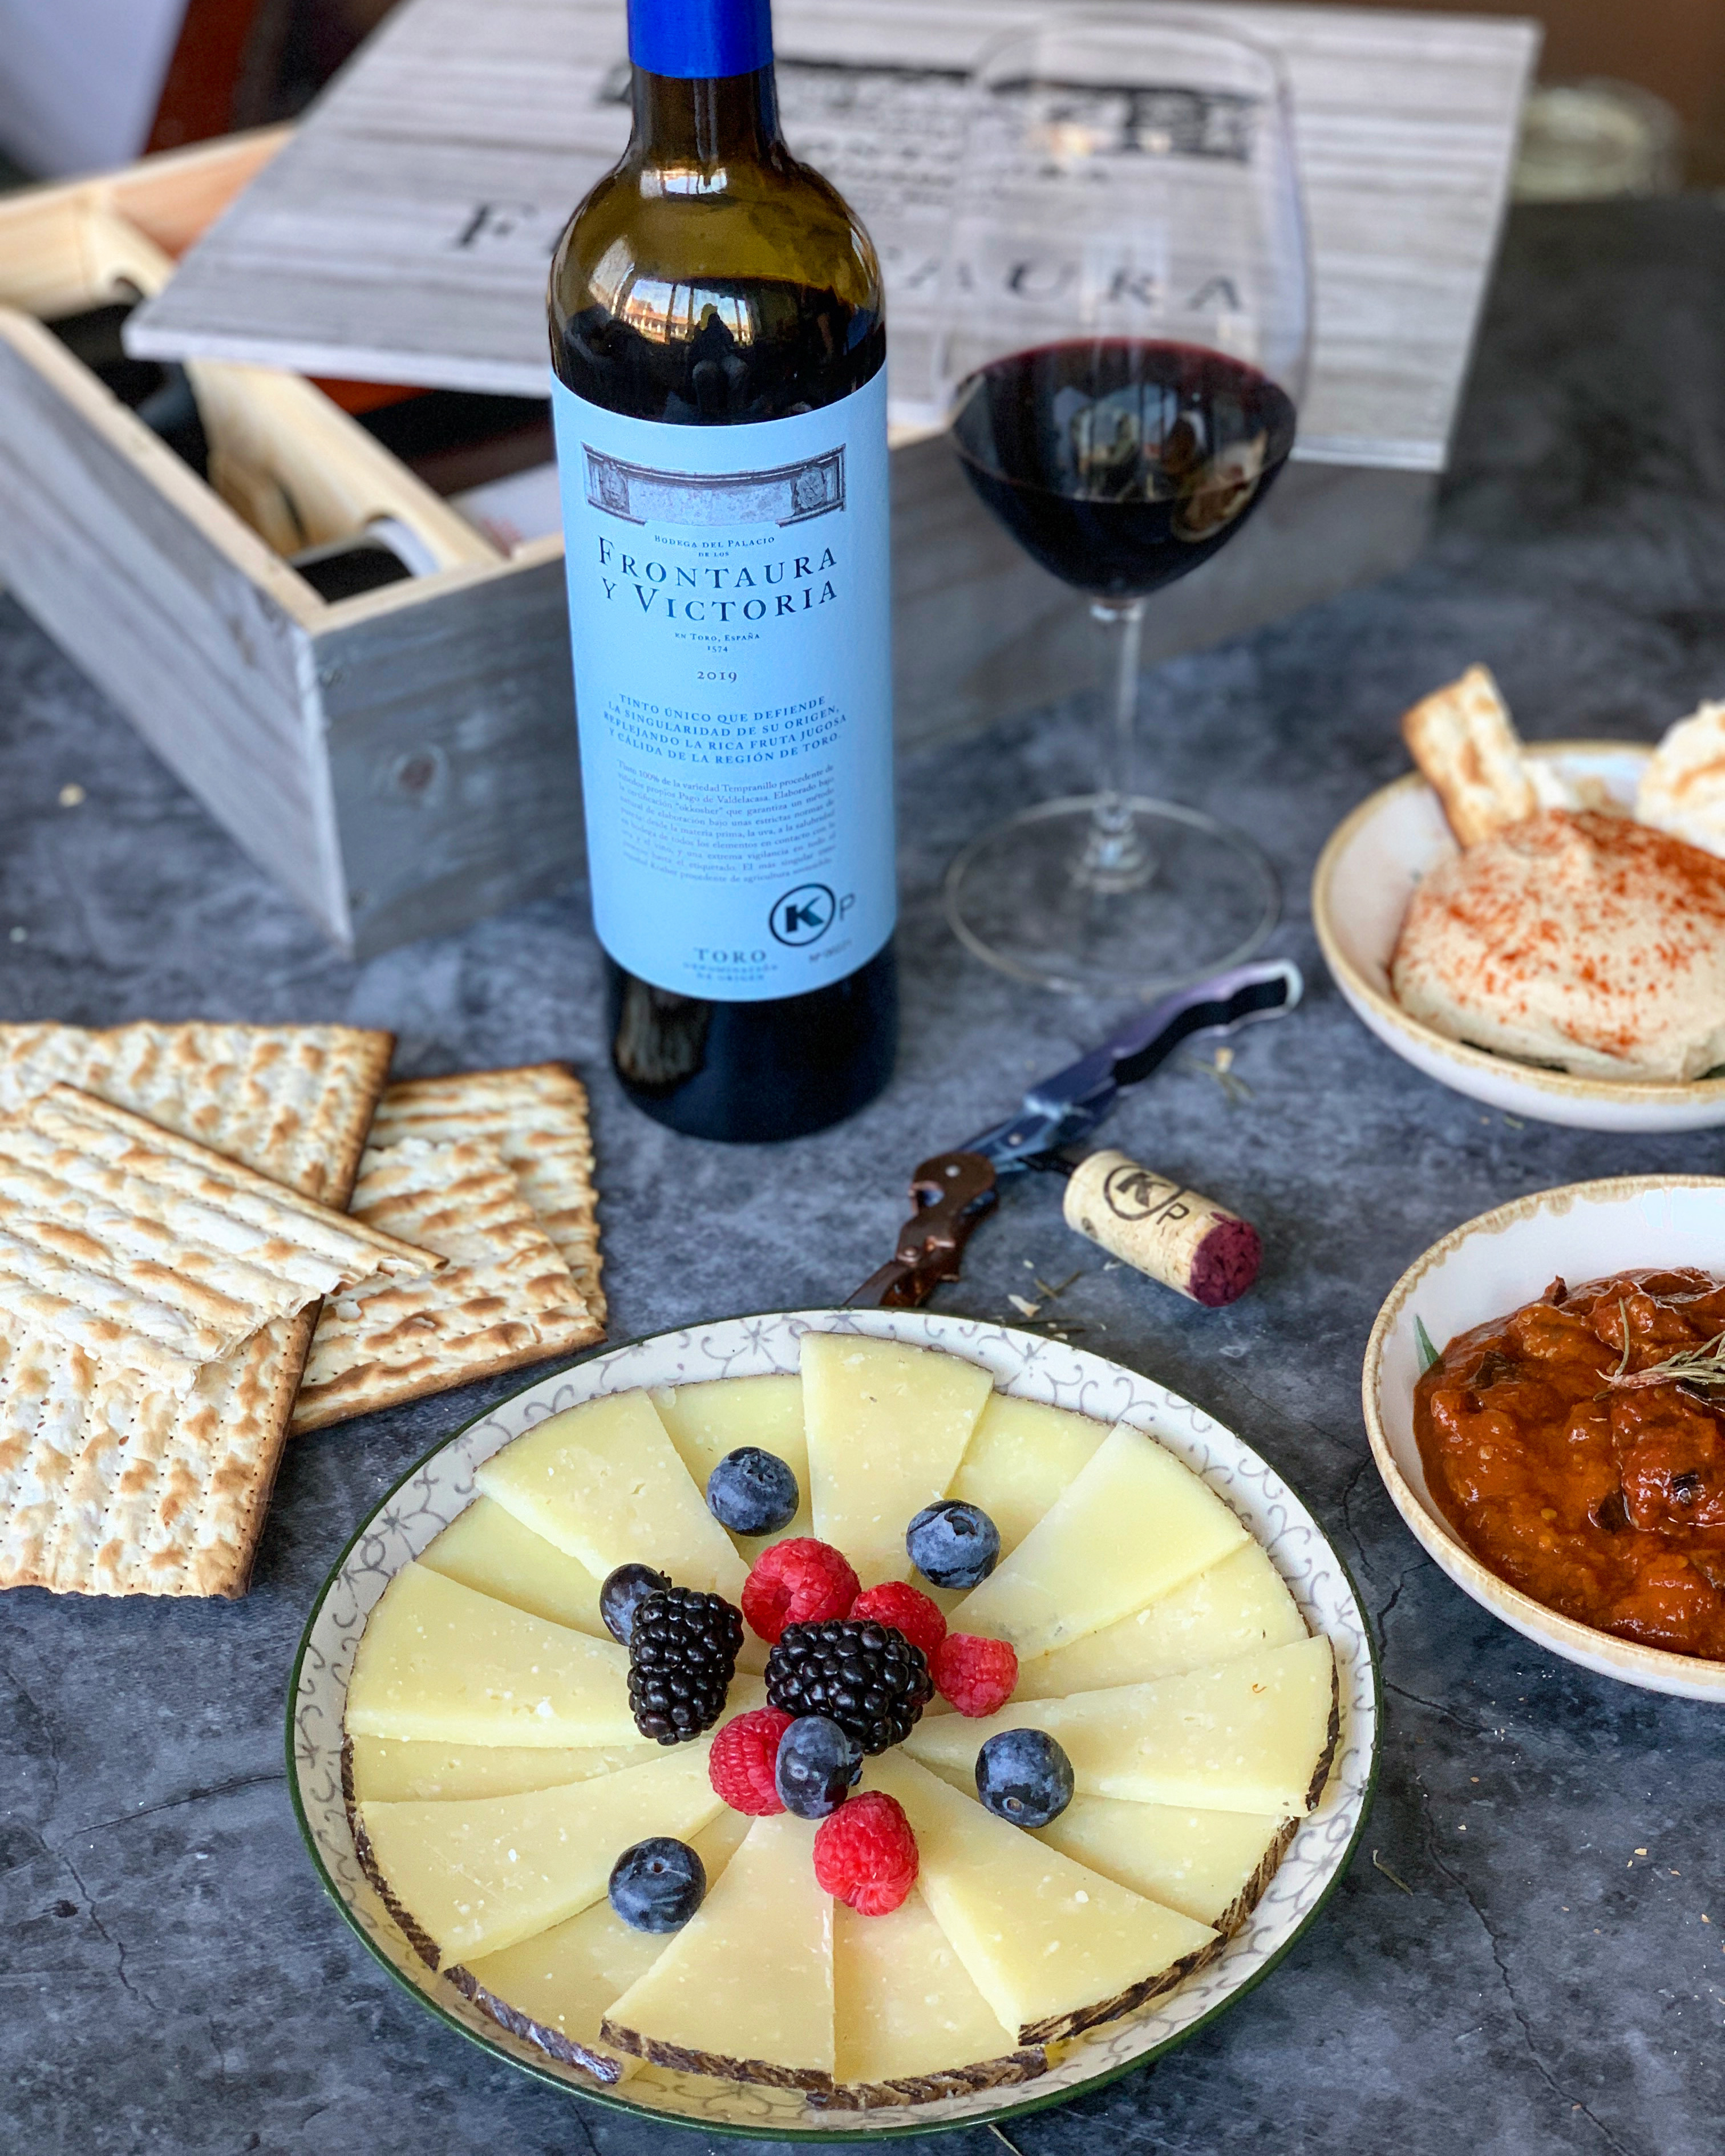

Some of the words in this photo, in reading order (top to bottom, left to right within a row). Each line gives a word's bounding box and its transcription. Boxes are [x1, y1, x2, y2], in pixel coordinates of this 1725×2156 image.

[655, 535, 697, 548] BODEGA
[728, 537, 775, 547] PALACIO
[598, 535, 837, 588] FRONTAURA
[601, 576, 618, 601] Y
[633, 580, 837, 622] VICTORIA
[690, 633, 720, 642] TORO,
[725, 633, 760, 641] ESPAÑA
[697, 671, 738, 683] 2019
[609, 701, 621, 714] LA
[625, 709, 730, 736] SINGULARIDAD
[737, 727, 756, 736] DE
[762, 723, 779, 734] SU
[784, 705, 839, 729] ORIGEN,
[619, 693, 659, 714] TINTO
[665, 707, 711, 722] ÚNICO
[717, 714, 748, 725] QUE
[754, 696, 825, 721] DEFIENDE
[604, 711, 679, 745] REFLEJANDO
[686, 739, 702, 749] LA
[708, 742, 744, 750] RICA
[750, 734, 796, 749] FRUTA
[800, 715, 847, 741] JUGOSA
[610, 727, 614, 735] Y
[618, 733, 662, 756] CÁLIDA
[668, 750, 686, 760] DE
[692, 754, 709, 763] LA
[715, 751, 774, 764] REGIÓN
[780, 747, 798, 758] DE
[803, 732, 841, 753] TORO.
[617, 759, 637, 775] Tinto
[639, 770, 659, 783] 100%
[662, 777, 671, 786] de
[674, 779, 681, 788] la
[683, 783, 719, 792] variedad
[721, 782, 777, 794] Tempranillo
[779, 770, 824, 789] procedente
[646, 786, 676, 798] propios
[679, 791, 699, 803] Pago
[774, 783, 816, 799] Elaborado
[819, 776, 834, 788] bajo
[619, 782, 625, 791] la
[627, 789, 673, 808] certificación
[726, 808, 744, 817] que
[747, 803, 787, 816] garantiza
[646, 806, 655, 815] de
[658, 811, 705, 825] elaboración
[709, 818, 728, 829] bajo
[756, 814, 791, 825] estrictas
[795, 804, 823, 819] normas
[671, 823, 678, 832] la
[681, 828, 712, 837] materia
[659, 832, 668, 841] de
[671, 835, 694, 846] todos
[697, 839, 709, 848] los
[775, 831, 810, 845] contacto
[748, 849, 789, 860] vigilancia
[693, 947, 767, 963] TORO
